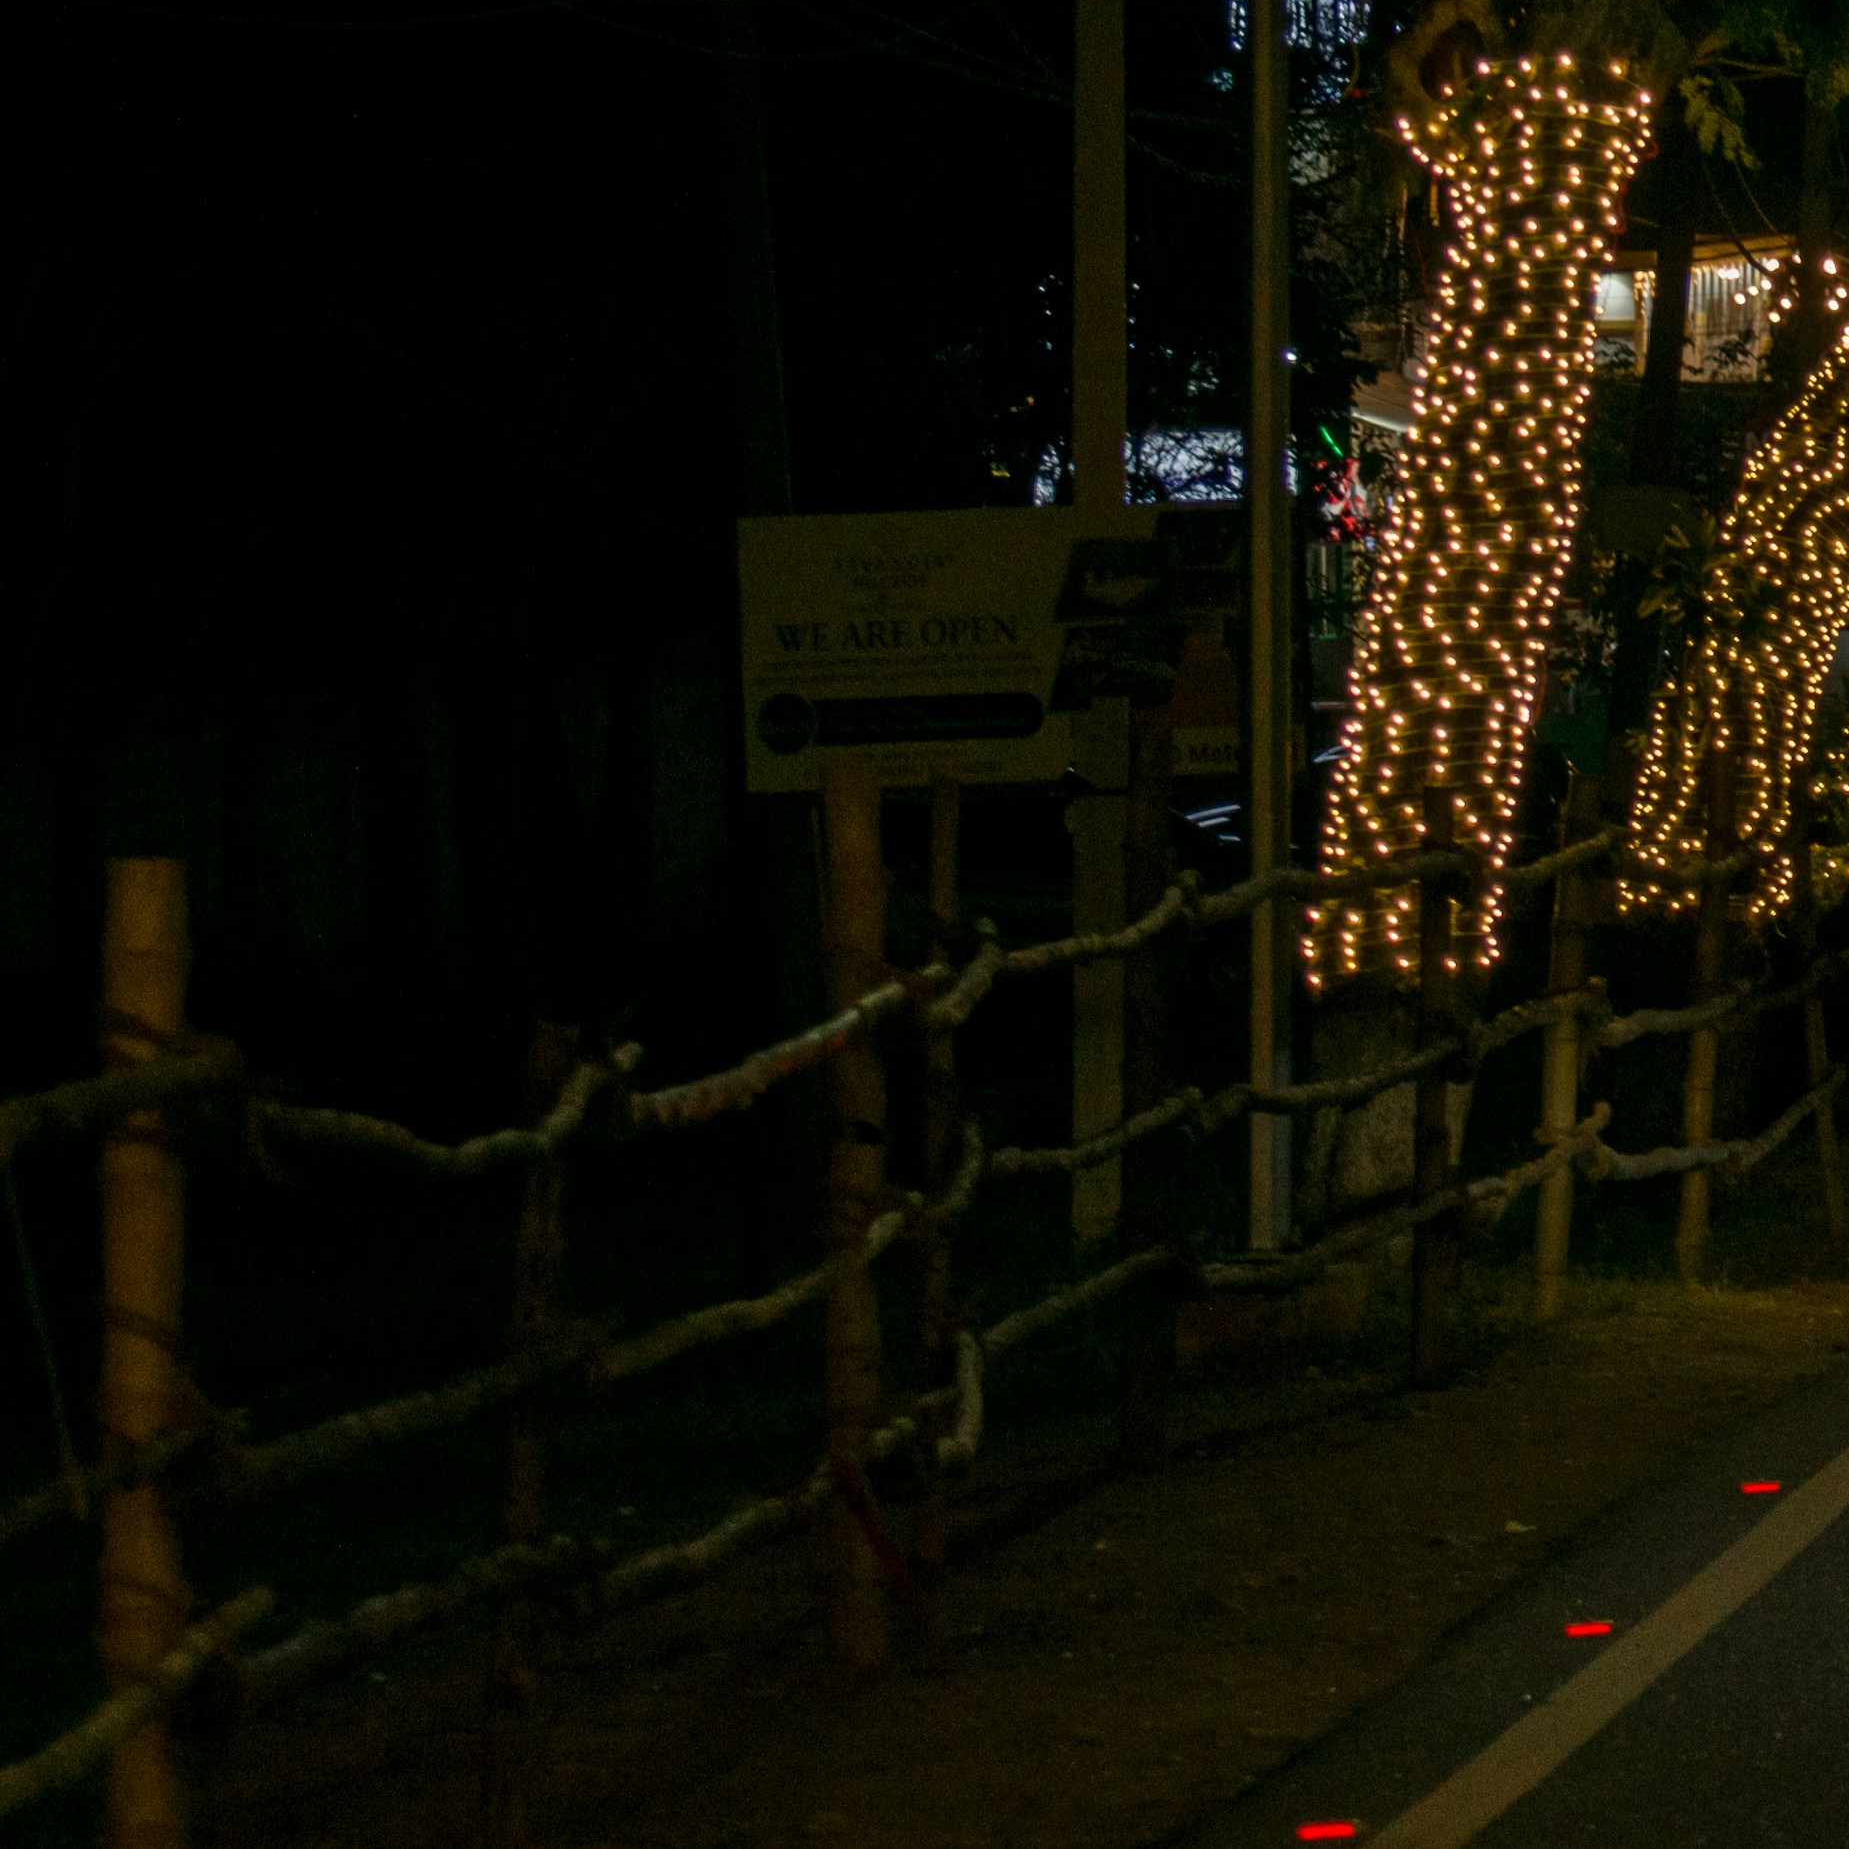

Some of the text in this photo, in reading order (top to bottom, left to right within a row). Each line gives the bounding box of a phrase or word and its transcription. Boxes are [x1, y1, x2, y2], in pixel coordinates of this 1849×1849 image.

[773, 614, 1019, 652] WE ARE OPEN
